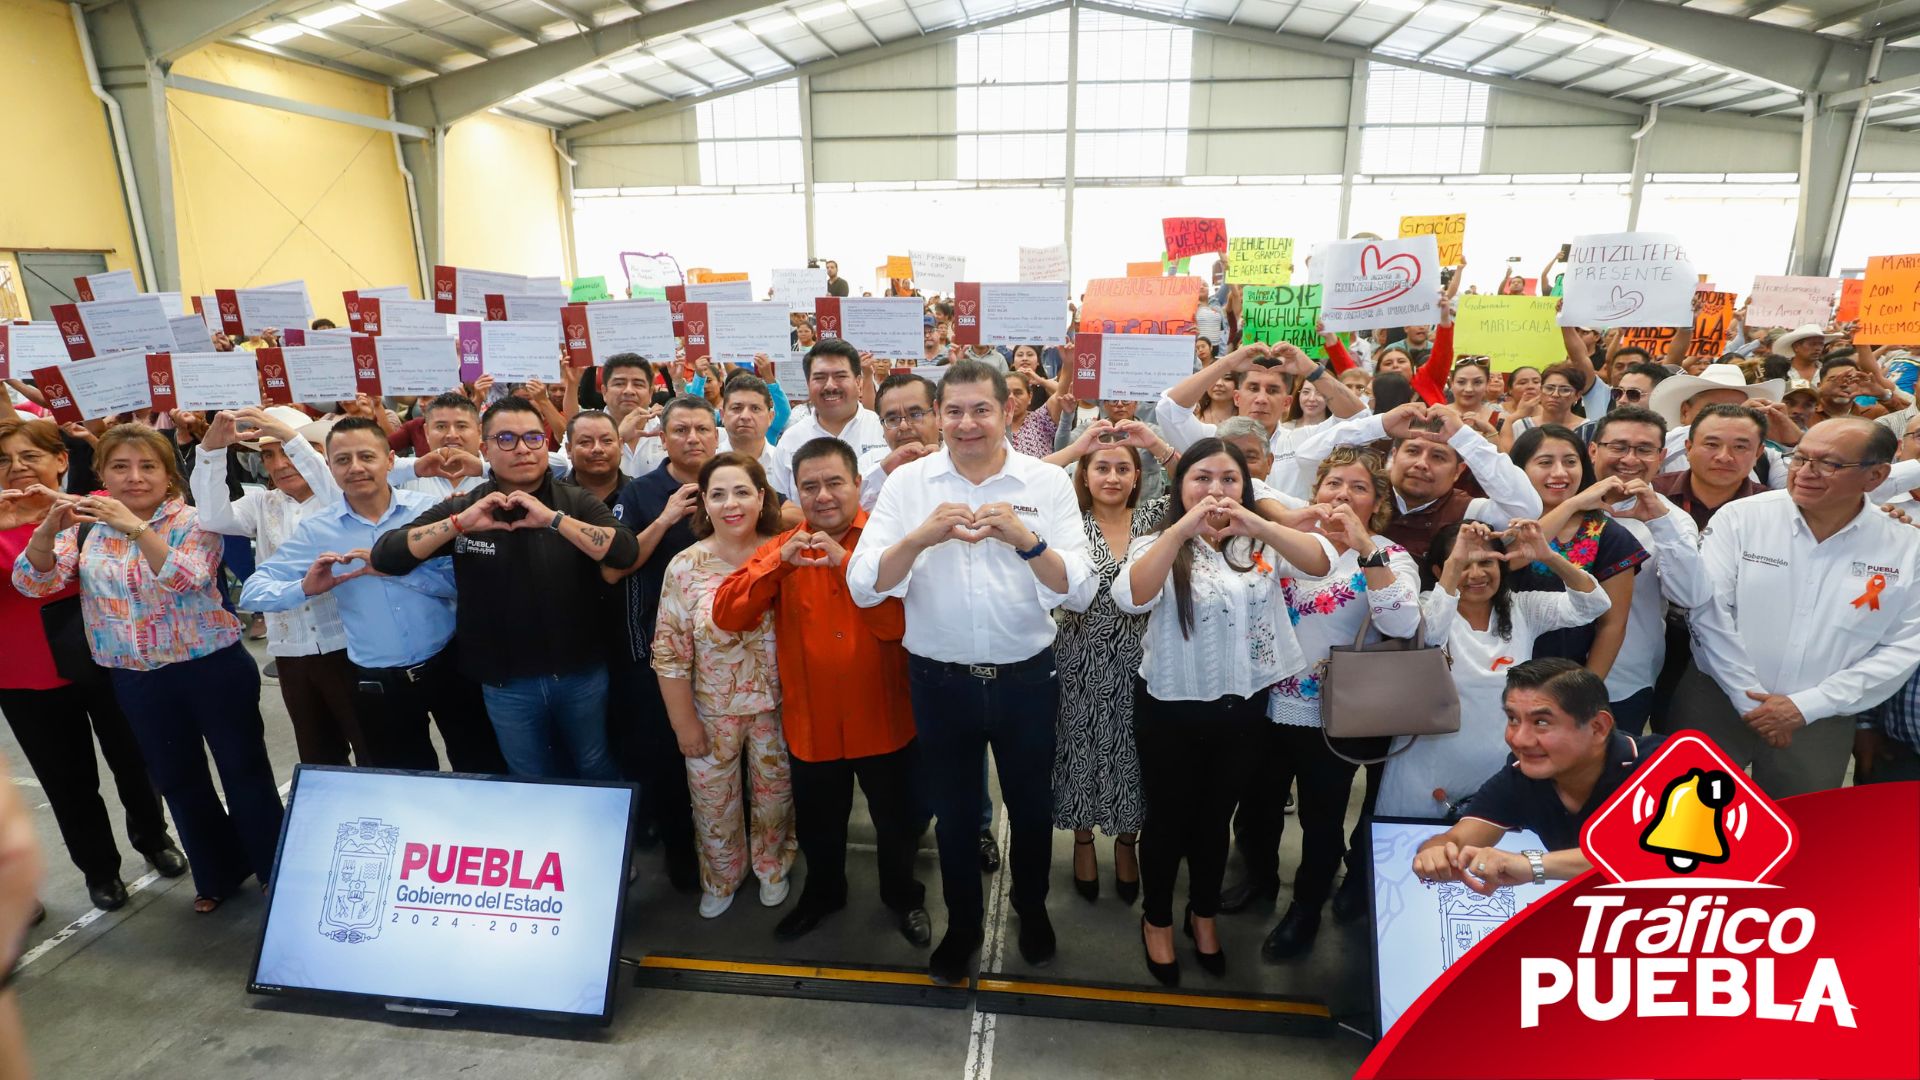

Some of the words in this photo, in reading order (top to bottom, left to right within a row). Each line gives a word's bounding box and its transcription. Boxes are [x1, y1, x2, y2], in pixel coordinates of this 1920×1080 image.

[1180, 219, 1218, 232] AMOR
[1400, 216, 1465, 235] Gracias
[1166, 232, 1225, 251] PUEBLA
[1229, 237, 1293, 251] HUEHUETLAN
[1235, 251, 1249, 262] EL
[1254, 251, 1287, 260] GRANDE
[1574, 266, 1673, 281] PRESENTE
[1274, 284, 1320, 307] DIF
[1868, 284, 1894, 298] CON
[1245, 306, 1321, 328] HUEHUET
[1344, 309, 1374, 320] AMOR
[1863, 303, 1872, 316] Y
[1880, 304, 1903, 317] CON
[958, 317, 976, 325] OBRA
[1480, 319, 1551, 334] MARISCALA
[1863, 321, 1920, 335] HACEMOS
[463, 355, 479, 363] OBRA
[1013, 505, 1038, 513] PUEBLA
[467, 540, 496, 549] PUEBLA
[1742, 551, 1789, 567] Gobernación
[1867, 565, 1900, 575] PUEBLA
[400, 842, 565, 892] PUEBLA
[396, 884, 473, 907] Gobierno
[475, 891, 500, 910] del
[504, 892, 563, 914] Estado
